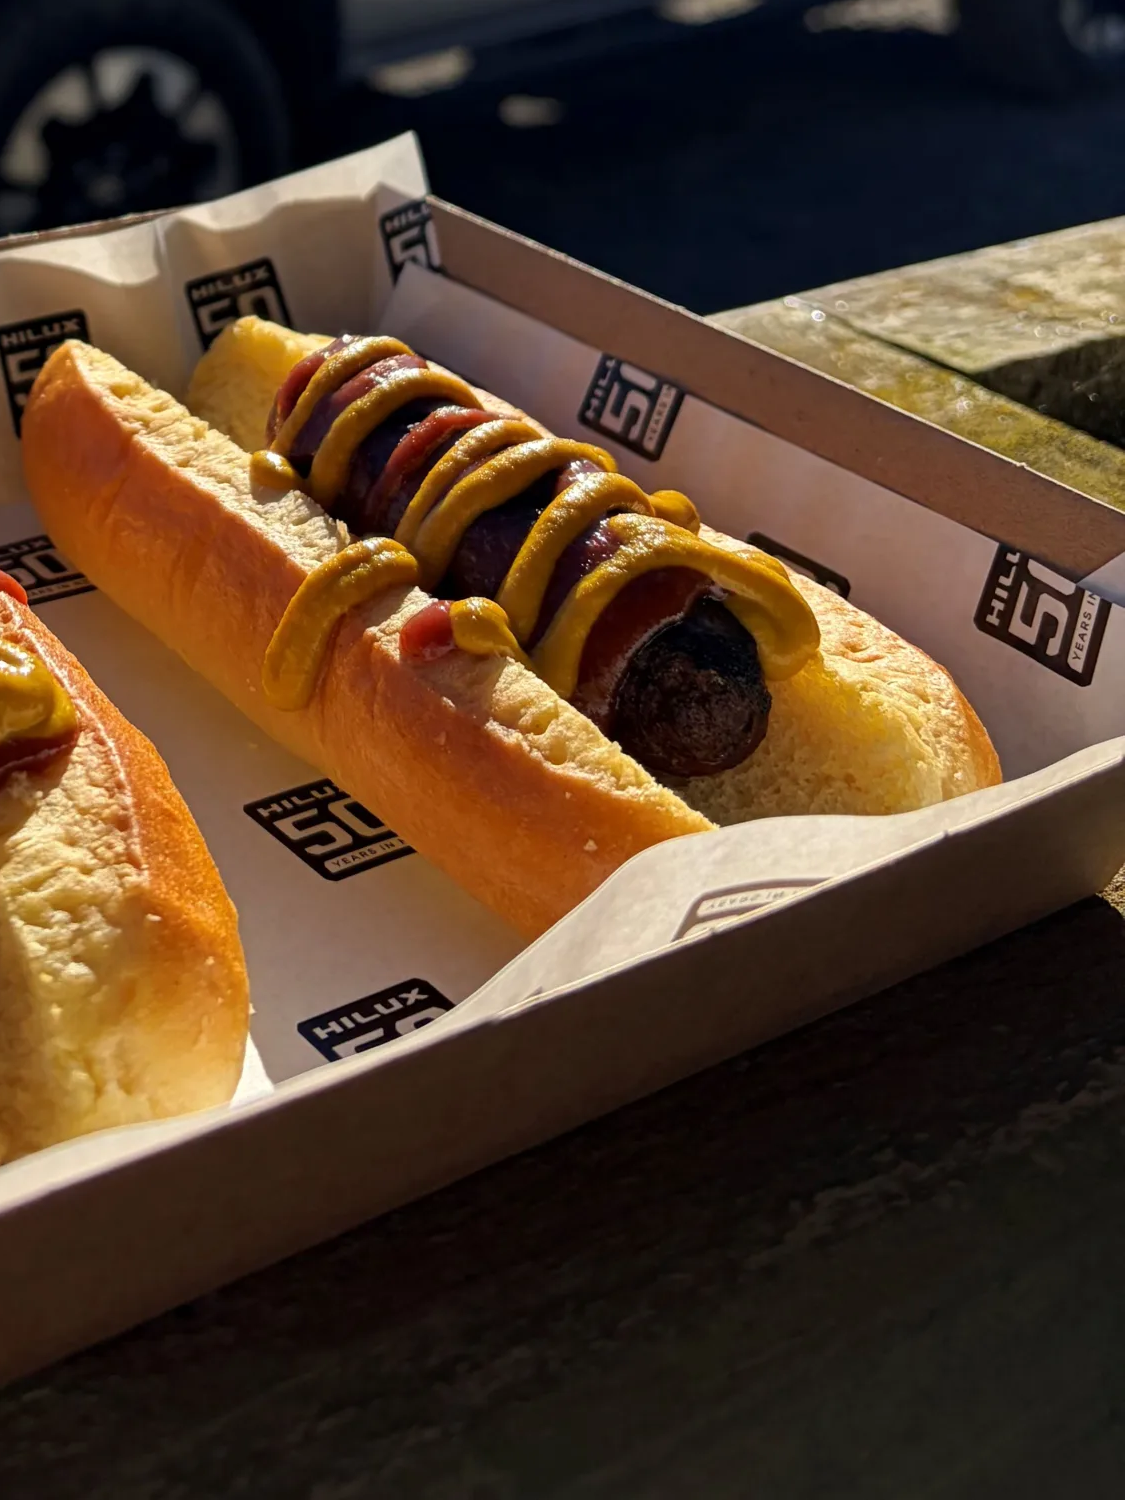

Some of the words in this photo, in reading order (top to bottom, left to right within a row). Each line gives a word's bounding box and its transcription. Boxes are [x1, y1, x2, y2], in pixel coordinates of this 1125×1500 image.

[0, 318, 81, 349] HILUX
[1072, 610, 1093, 662] YEARS
[256, 784, 340, 818] HILU
[331, 848, 378, 868] YEARS
[380, 842, 396, 851] IN
[312, 987, 429, 1040] HILUX
